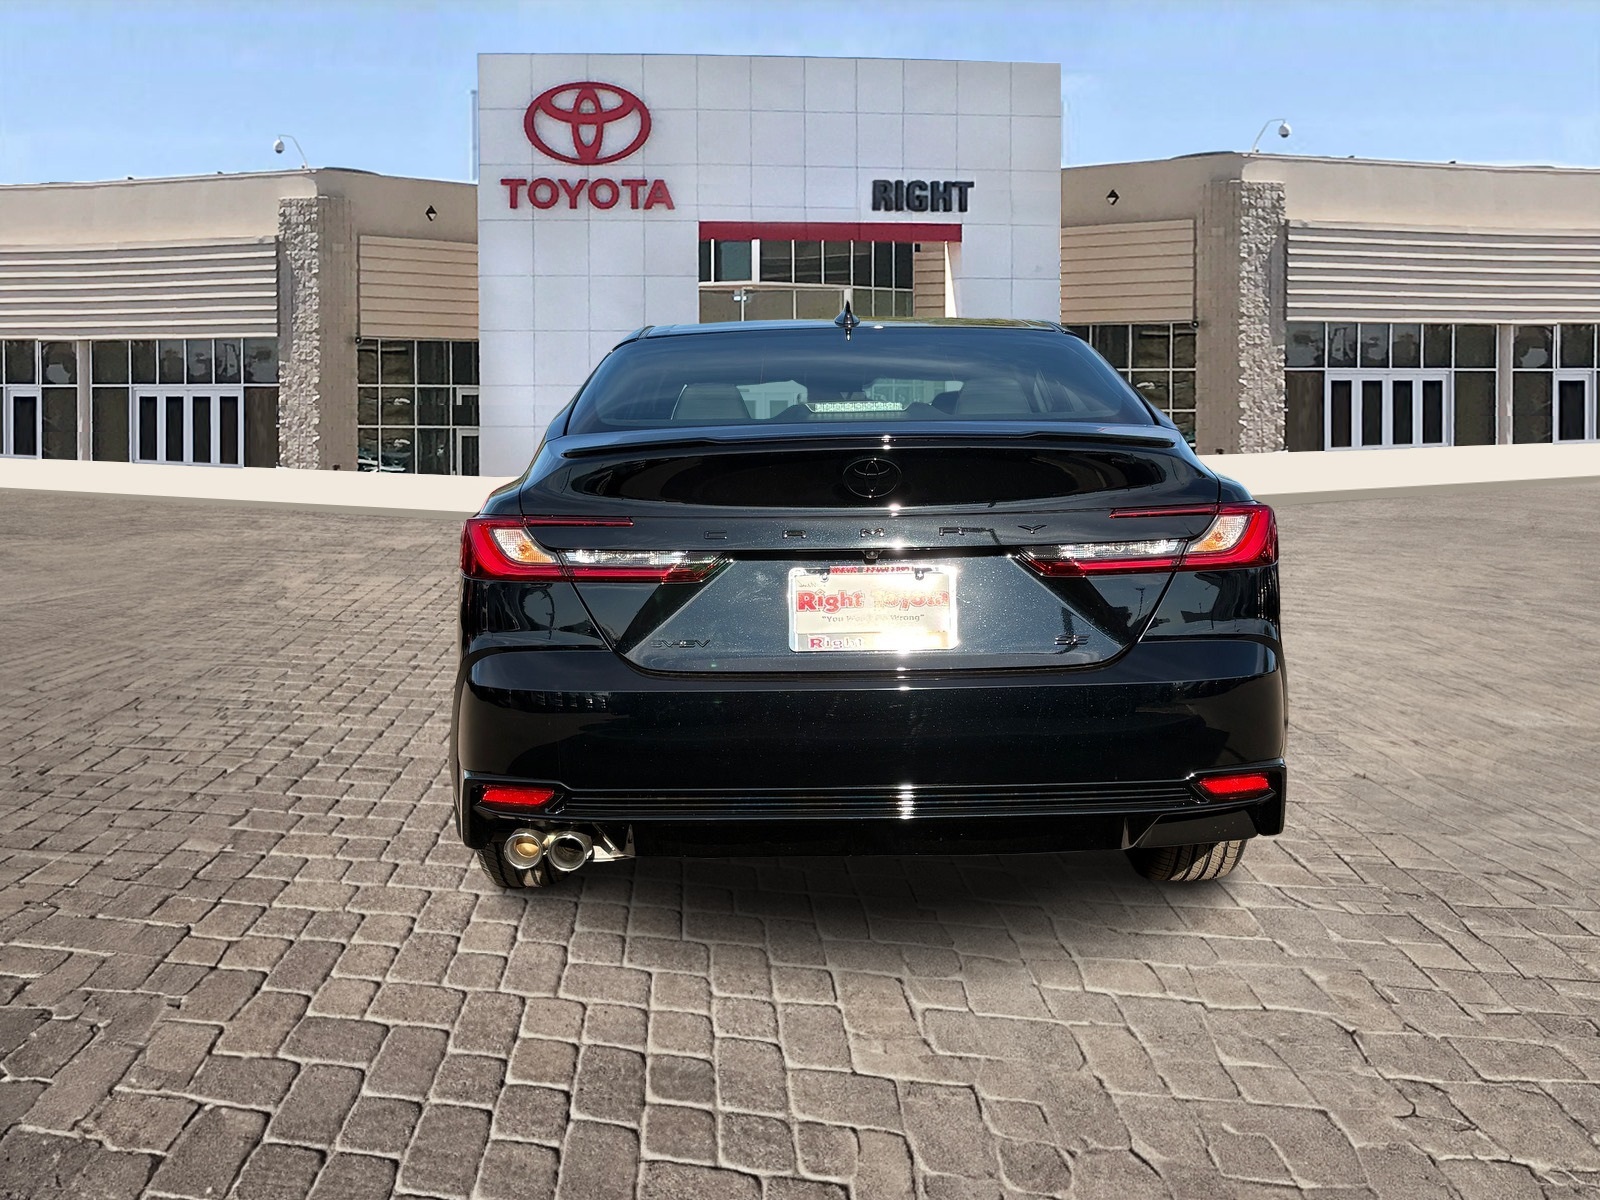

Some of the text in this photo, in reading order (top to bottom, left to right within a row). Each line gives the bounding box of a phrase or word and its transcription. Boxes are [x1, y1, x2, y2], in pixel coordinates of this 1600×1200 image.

[500, 178, 675, 210] TOYOTA
[872, 179, 975, 213] RIGHT
[796, 589, 864, 613] Right
